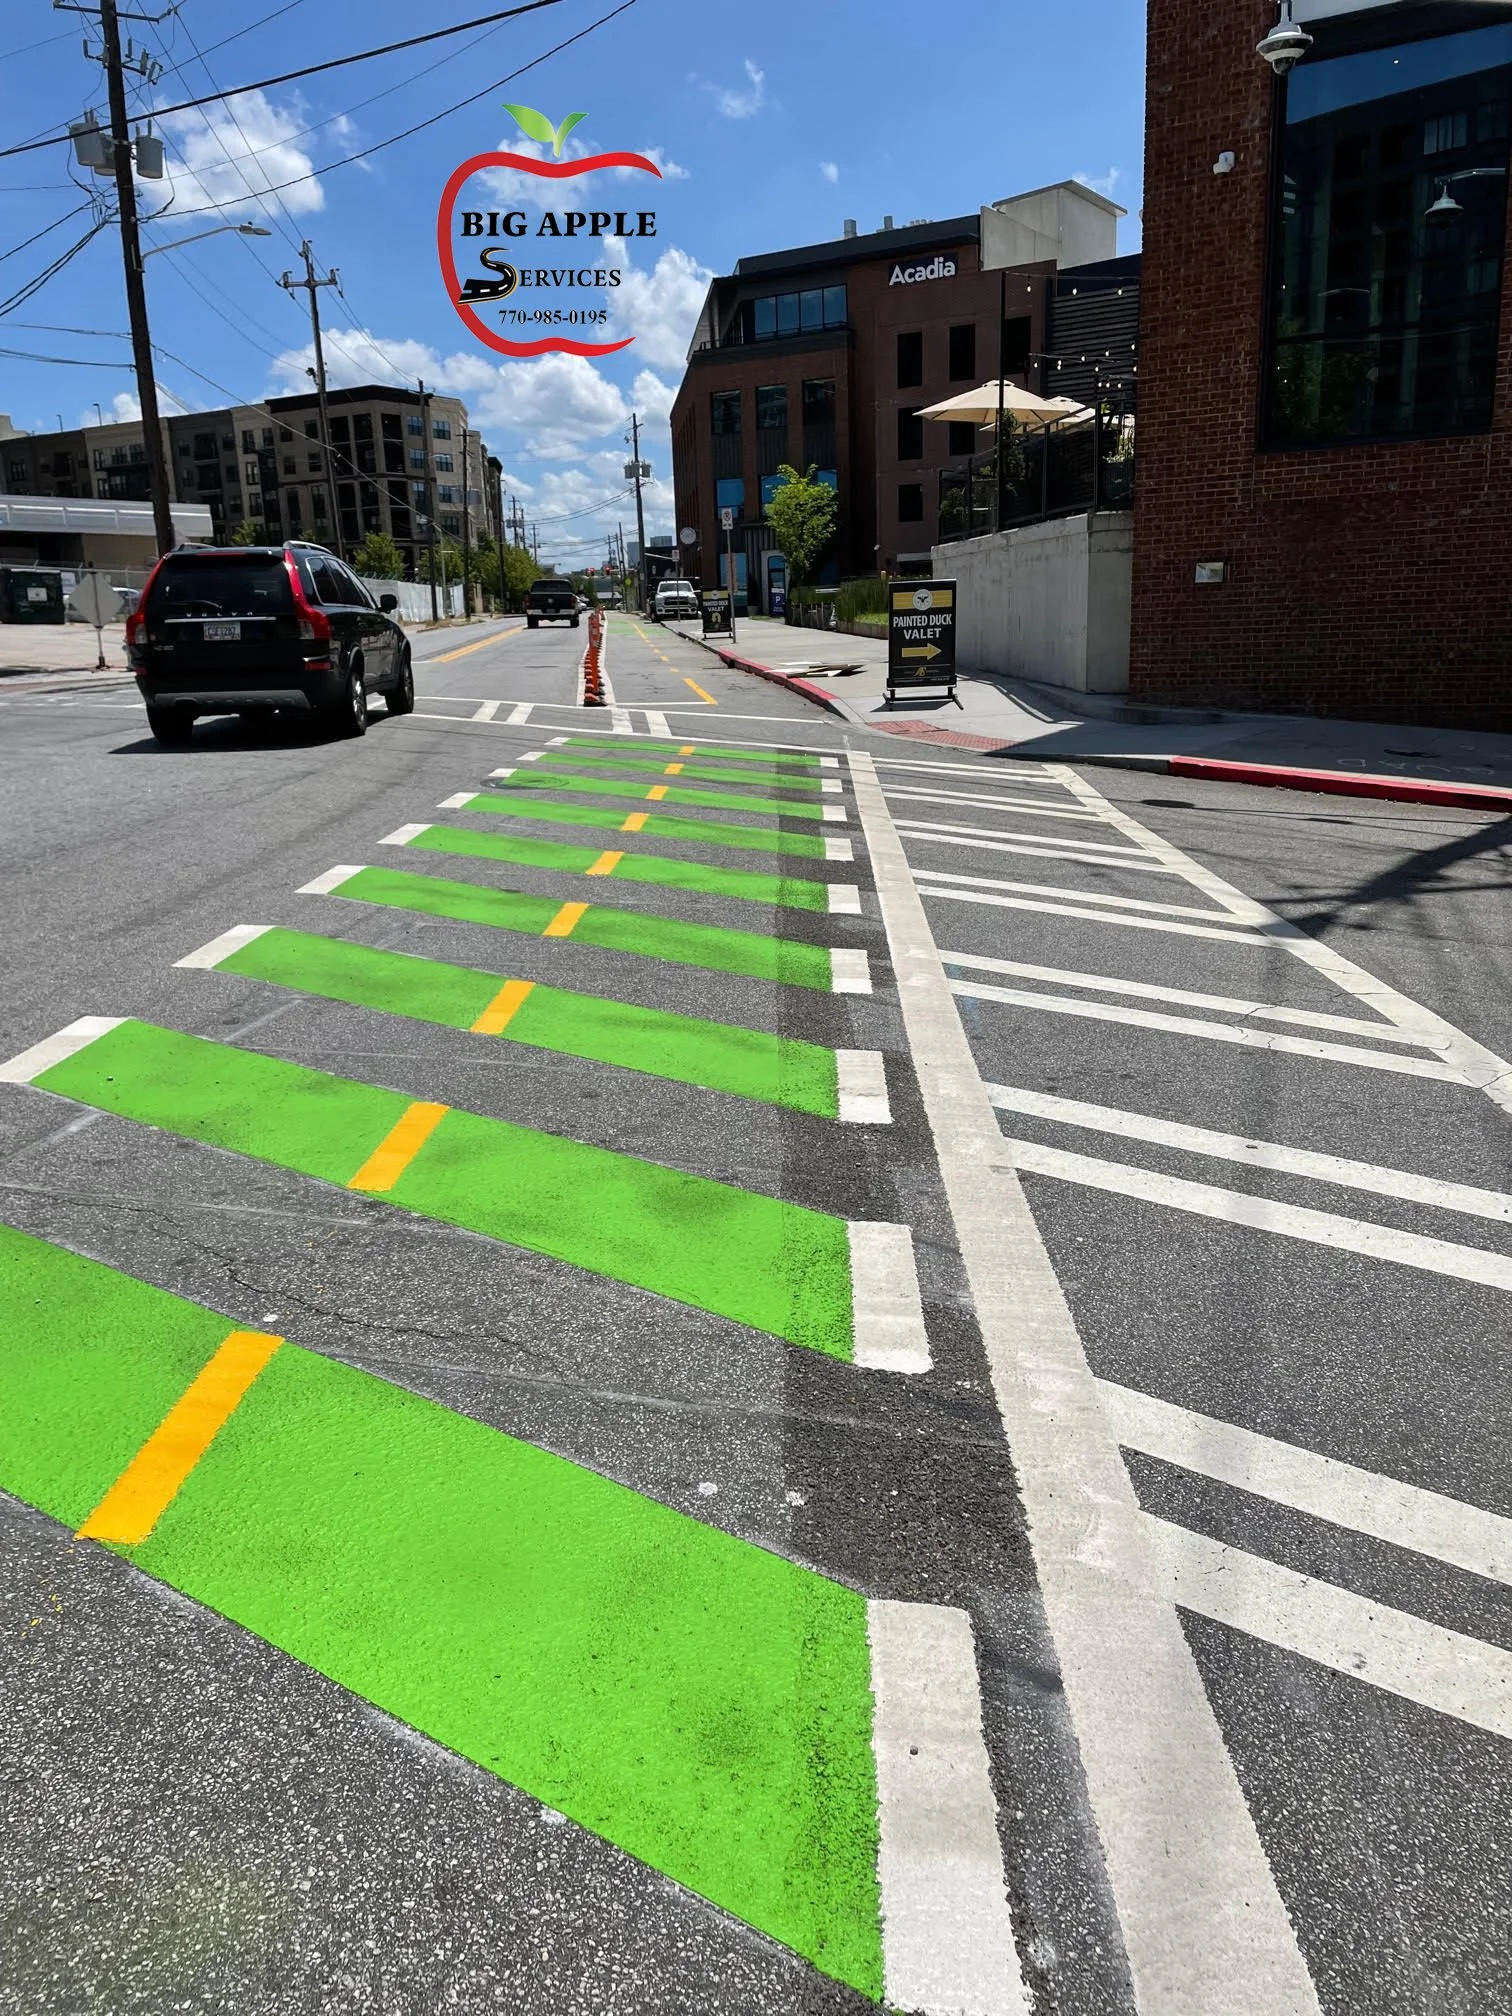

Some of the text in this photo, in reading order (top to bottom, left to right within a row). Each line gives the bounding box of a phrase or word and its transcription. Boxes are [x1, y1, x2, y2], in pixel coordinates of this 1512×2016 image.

[888, 256, 956, 286] Acadia
[893, 613, 952, 628] PAINTED DUCK
[903, 628, 942, 640] VALET
